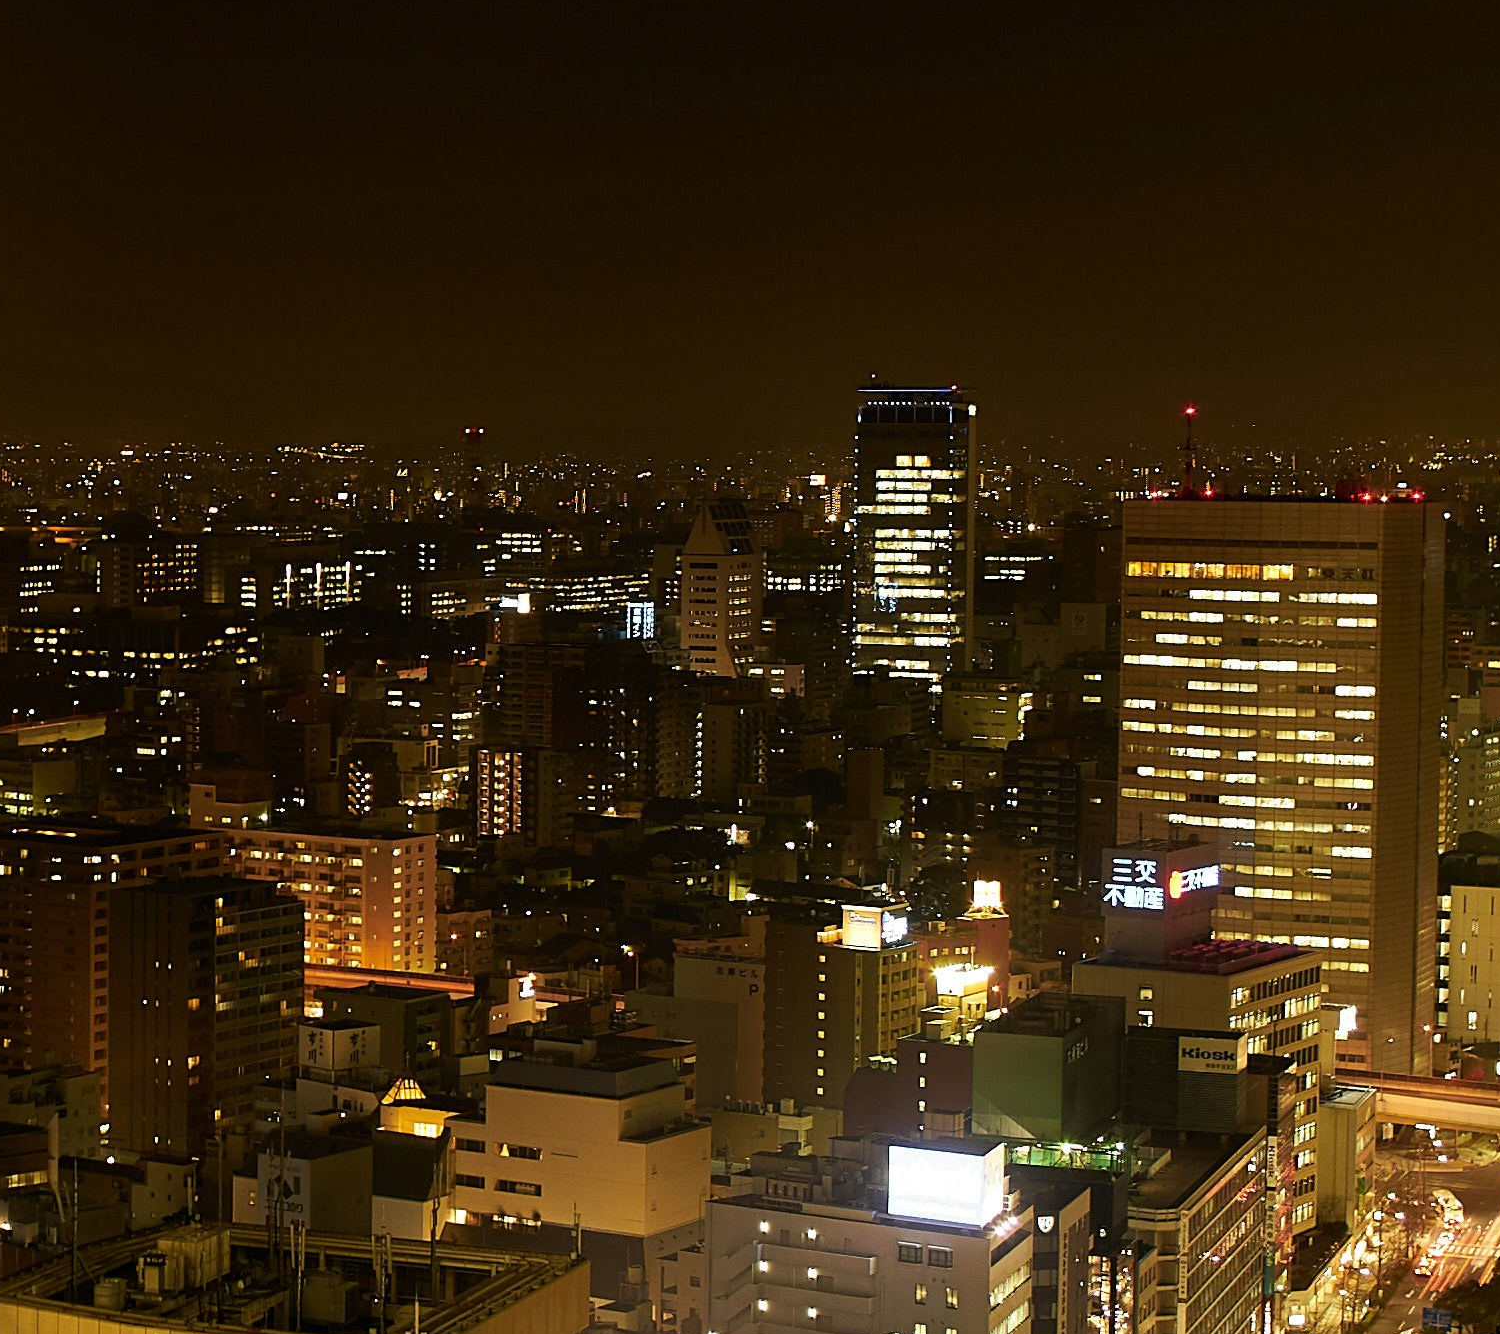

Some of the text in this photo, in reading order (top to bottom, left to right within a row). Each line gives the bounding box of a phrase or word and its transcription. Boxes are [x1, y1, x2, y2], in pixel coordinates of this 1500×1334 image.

[1112, 858, 1157, 884] 三交
[1102, 883, 1164, 910] 不動産
[749, 983, 759, 996] P
[1181, 1048, 1236, 1061] Kiosk
